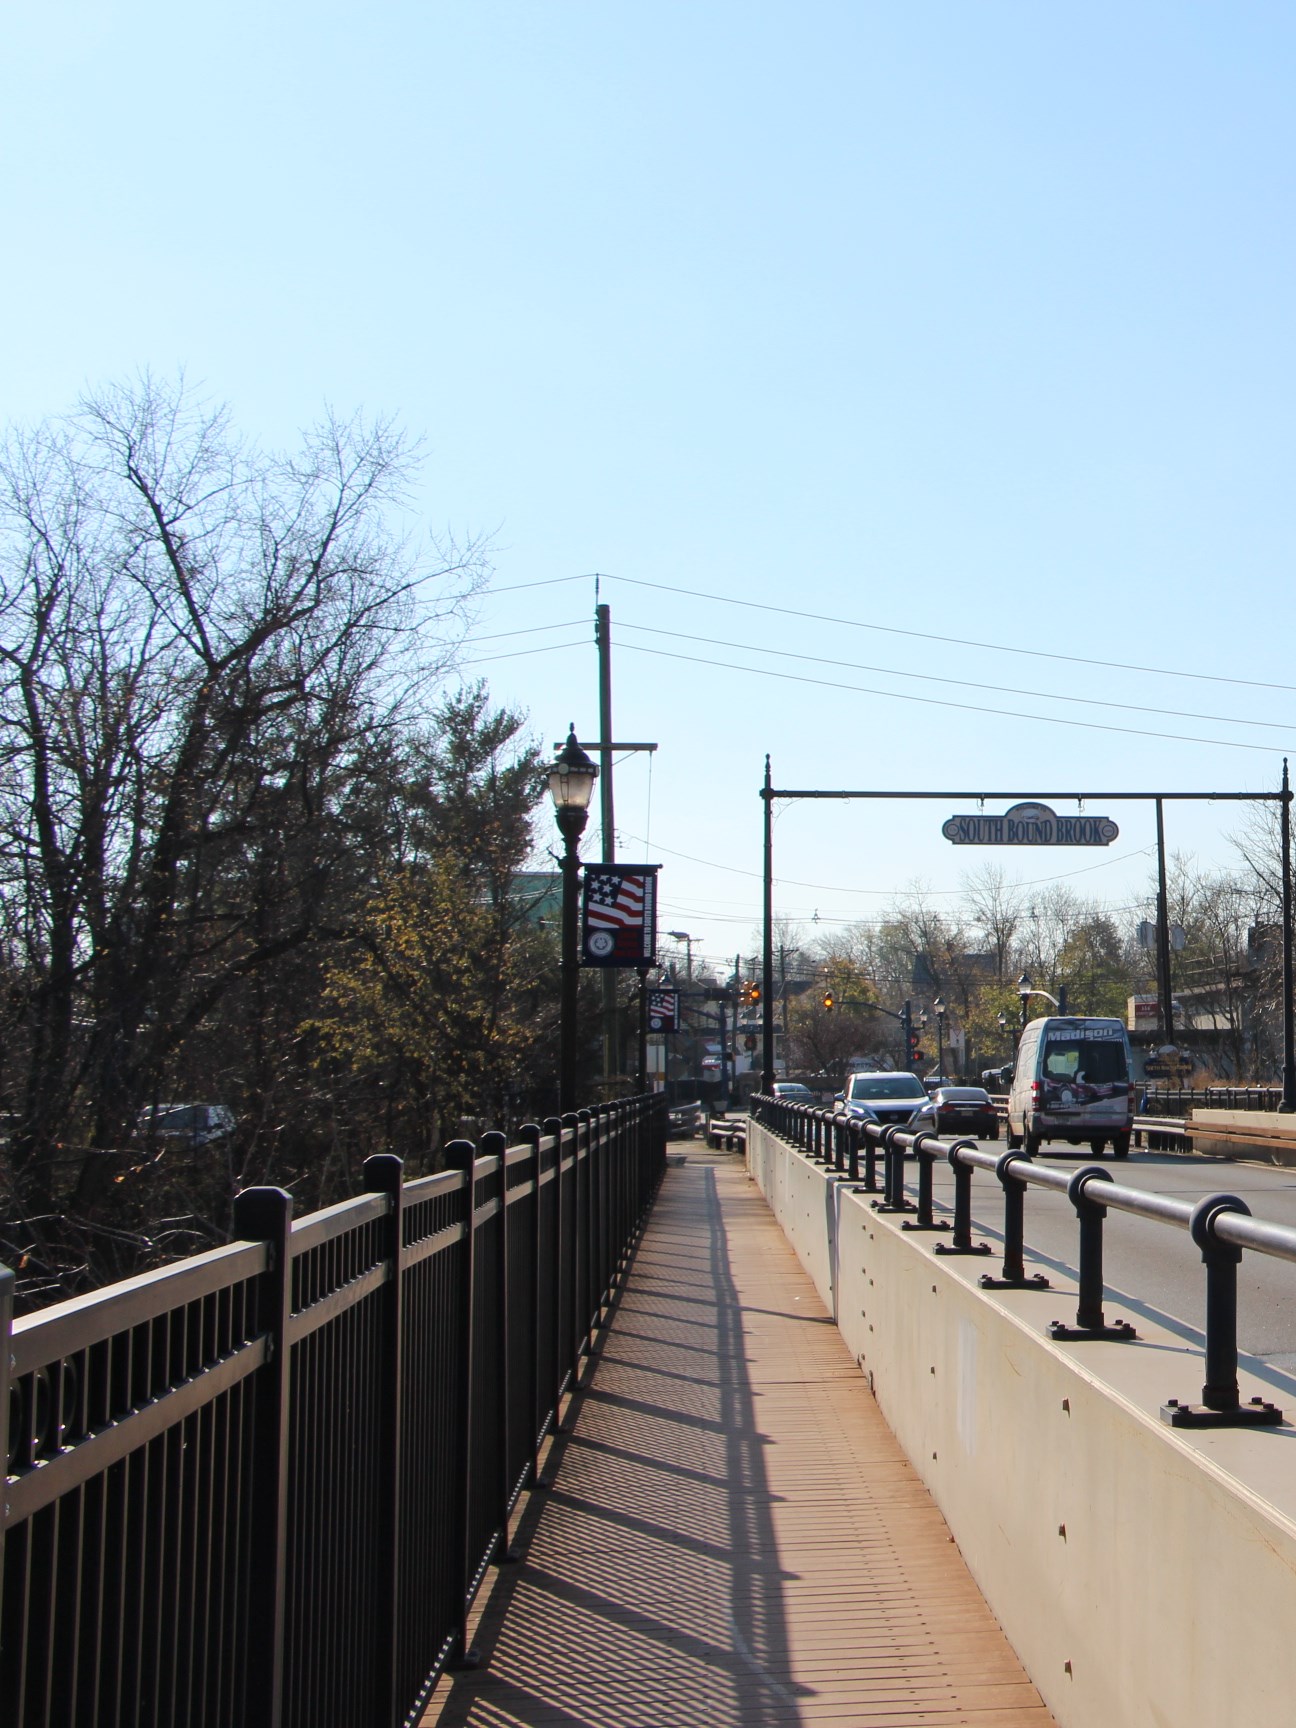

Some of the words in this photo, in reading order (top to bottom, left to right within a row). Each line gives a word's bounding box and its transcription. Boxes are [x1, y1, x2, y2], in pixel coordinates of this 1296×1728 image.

[959, 818, 1004, 842] SOUTH
[1007, 818, 1053, 843] BOUND
[1056, 819, 1103, 843] BROOK
[644, 911, 652, 926] SOUTH
[1047, 1028, 1113, 1041] Madison
